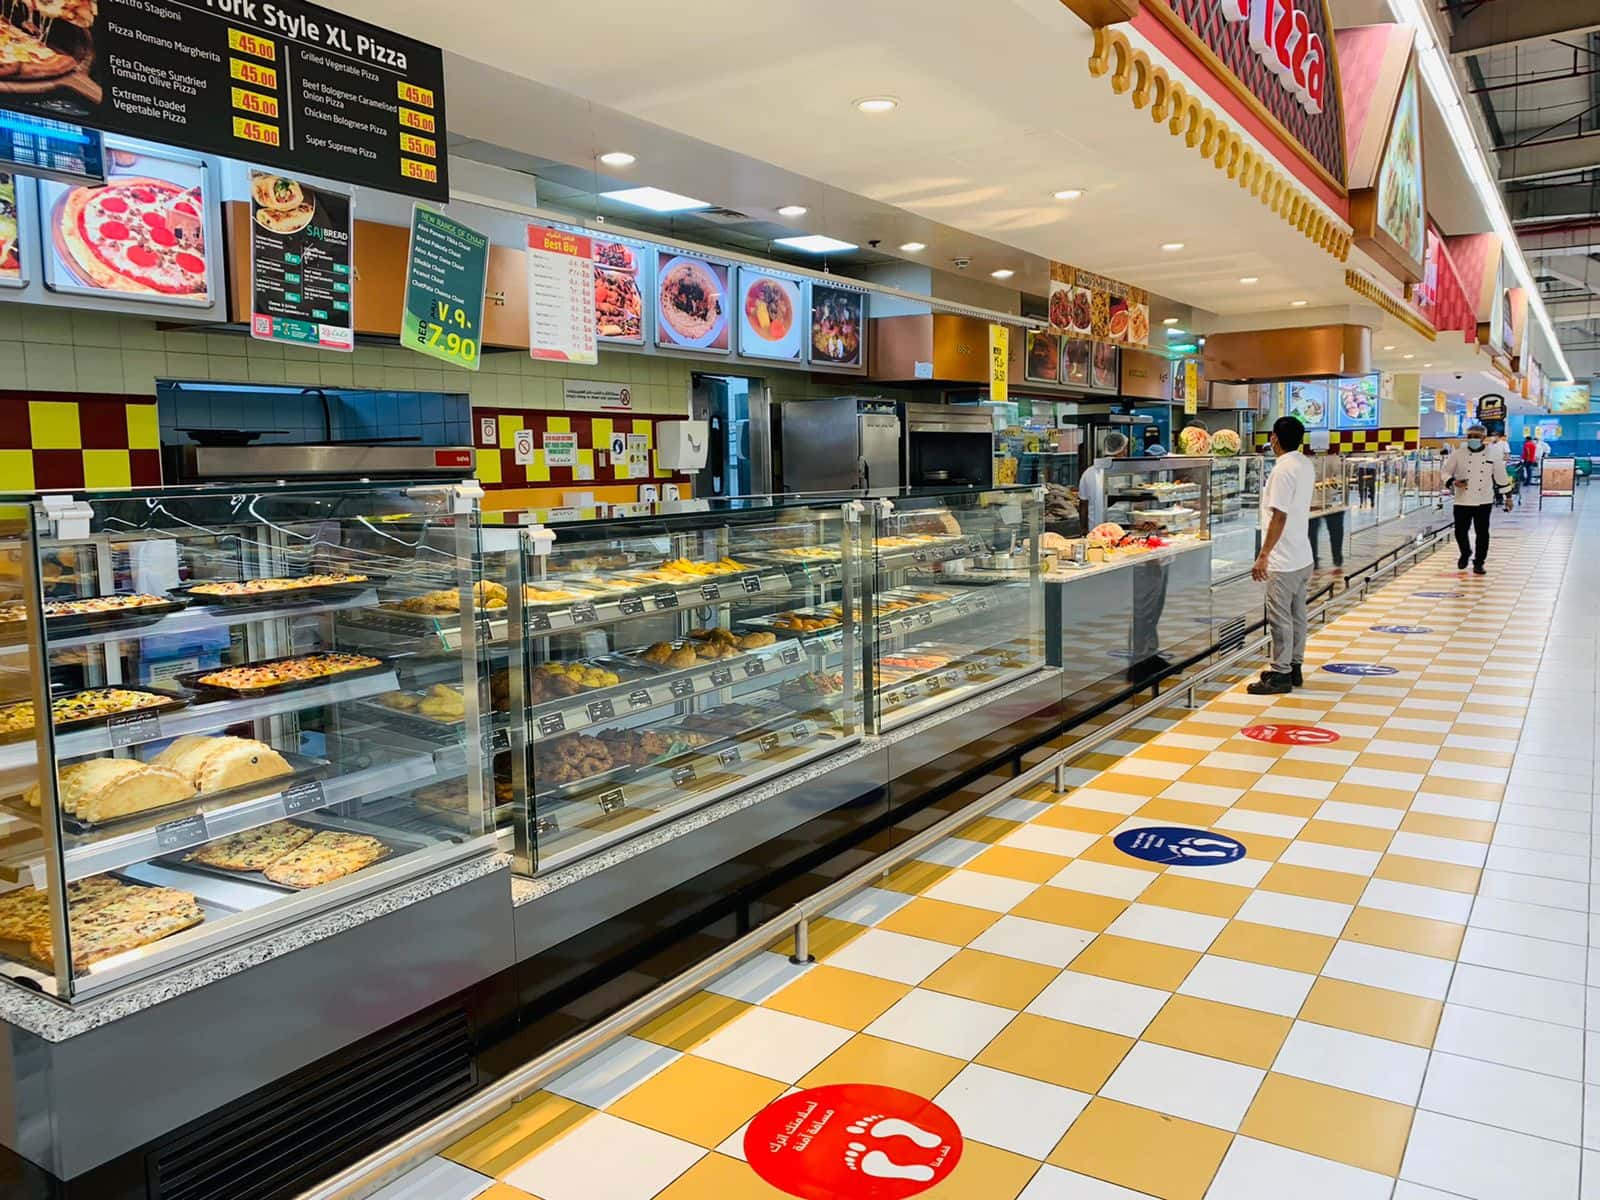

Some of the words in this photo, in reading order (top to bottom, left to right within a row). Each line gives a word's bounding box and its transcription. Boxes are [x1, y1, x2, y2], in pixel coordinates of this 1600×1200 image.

[144, 2, 182, 20] Stagioni
[108, 22, 134, 38] Pizza
[135, 30, 173, 49] Romano
[174, 41, 221, 62] Margherita
[207, 0, 257, 21] ork
[262, 3, 320, 40] Style
[325, 24, 353, 51] XL
[356, 35, 407, 70] Pizza
[239, 35, 273, 58] 45.00
[109, 55, 132, 69] Feta
[133, 61, 167, 78] Cheese
[168, 70, 207, 88] Sundried
[241, 64, 275, 87] 45.00
[301, 50, 324, 65] Grilled
[325, 57, 360, 76] Vegetable
[361, 69, 380, 82] Pizza
[110, 65, 146, 82] Tomato
[148, 75, 172, 89] Olive
[173, 81, 197, 96] Pizza
[302, 79, 320, 91] Beef
[112, 86, 152, 105] Extreme
[153, 96, 186, 113] Loaded
[242, 94, 276, 116] 45.00
[302, 90, 324, 104] Onion
[326, 95, 344, 109] Pizza
[405, 87, 432, 106] 45.00
[113, 99, 161, 118] Vegetable
[163, 111, 187, 124] Pizza
[304, 107, 332, 122] Chicken
[369, 124, 387, 136] Pizza
[407, 112, 433, 131] 45.00
[243, 123, 278, 145] 45.00
[305, 134, 327, 147] Super
[327, 140, 358, 155] Supreme
[359, 148, 377, 159] Pizza
[408, 137, 435, 156] 55.00
[409, 163, 436, 181] 55.00
[306, 224, 324, 241] SAJ
[324, 227, 348, 241] BREAD
[543, 237, 561, 250] Best
[563, 241, 578, 256] Buy
[417, 320, 427, 345] AED
[428, 323, 475, 361] 7.90
[785, 1100, 819, 1135] لسلامتك
[806, 1109, 835, 1135] مسافة
